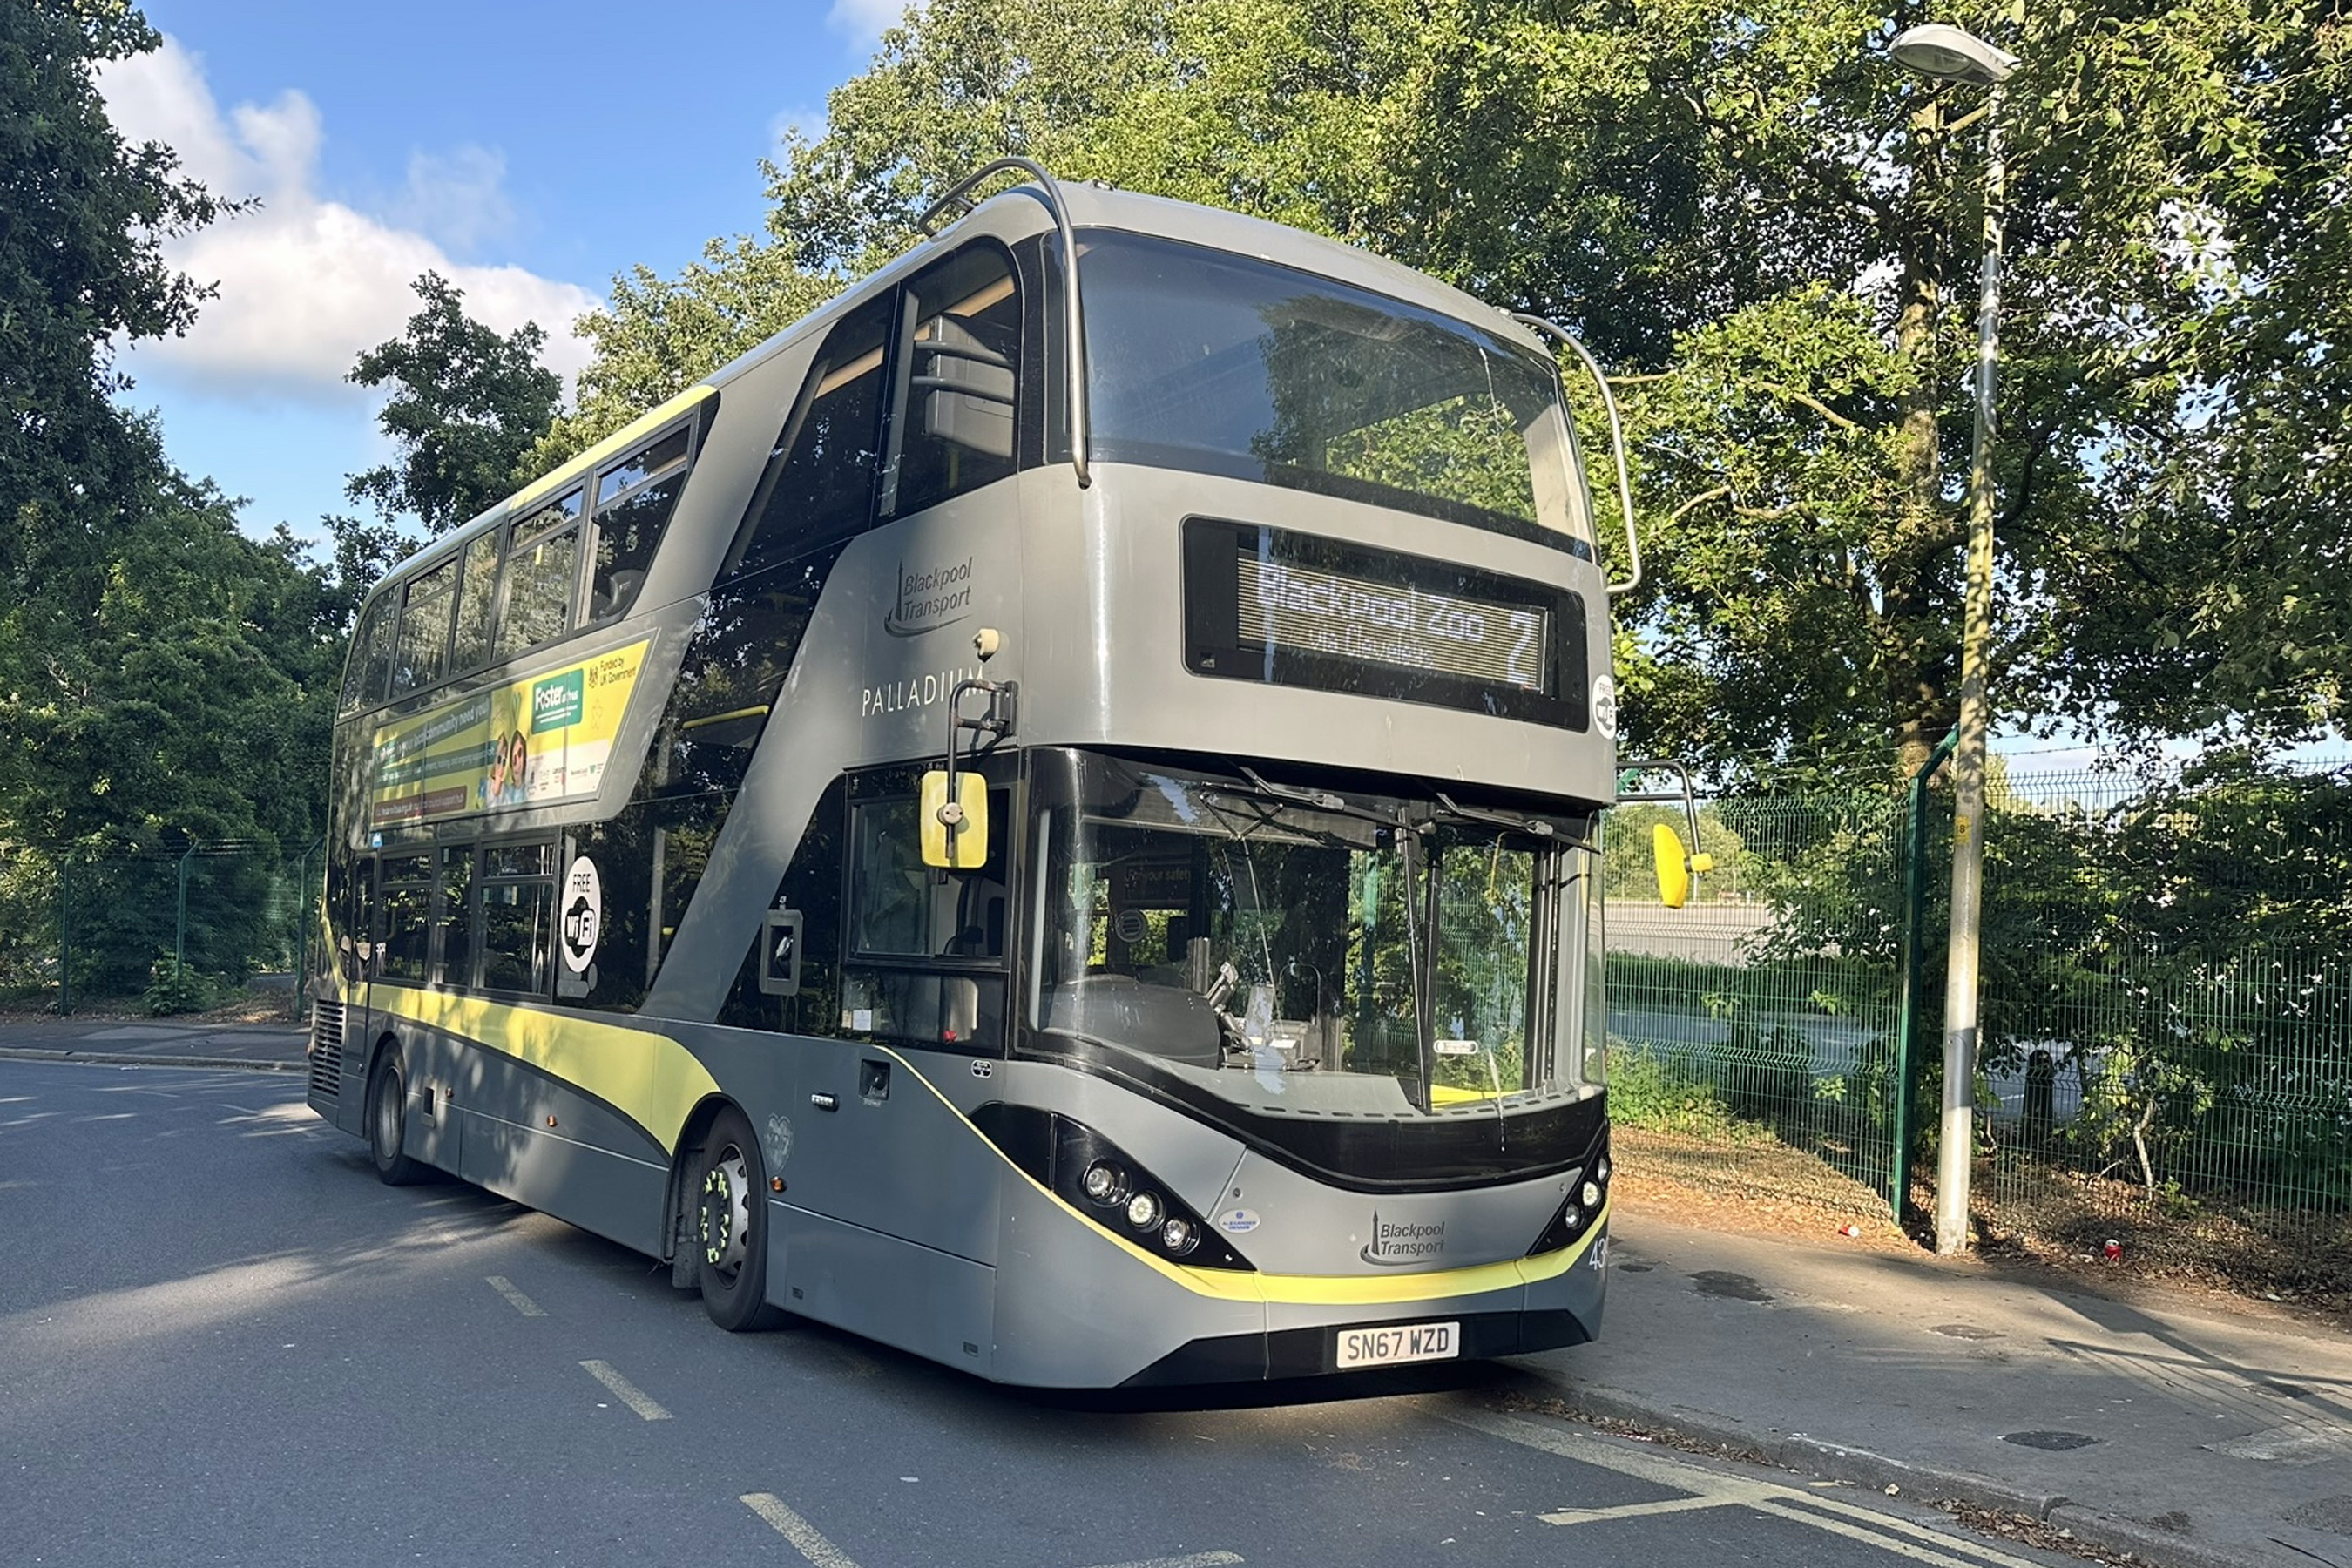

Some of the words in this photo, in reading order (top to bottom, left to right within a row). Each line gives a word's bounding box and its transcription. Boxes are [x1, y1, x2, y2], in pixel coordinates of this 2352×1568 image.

[903, 557, 973, 596] Blackpool
[903, 585, 971, 621] Transport
[1257, 562, 1416, 632] Blackpool
[1426, 594, 1484, 642] Zoo
[1308, 624, 1338, 653] via
[1507, 610, 1532, 684] 2
[600, 657, 618, 672] Funded
[535, 685, 564, 712] Foster
[862, 665, 984, 717] PALLADIUM
[573, 874, 591, 893] FREE
[1381, 1220, 1446, 1239] Blackpool
[1381, 1240, 1445, 1257] Transport
[1589, 1238, 1608, 1270] 43
[1348, 1331, 1403, 1361] SN67
[1410, 1327, 1450, 1355] WZD
